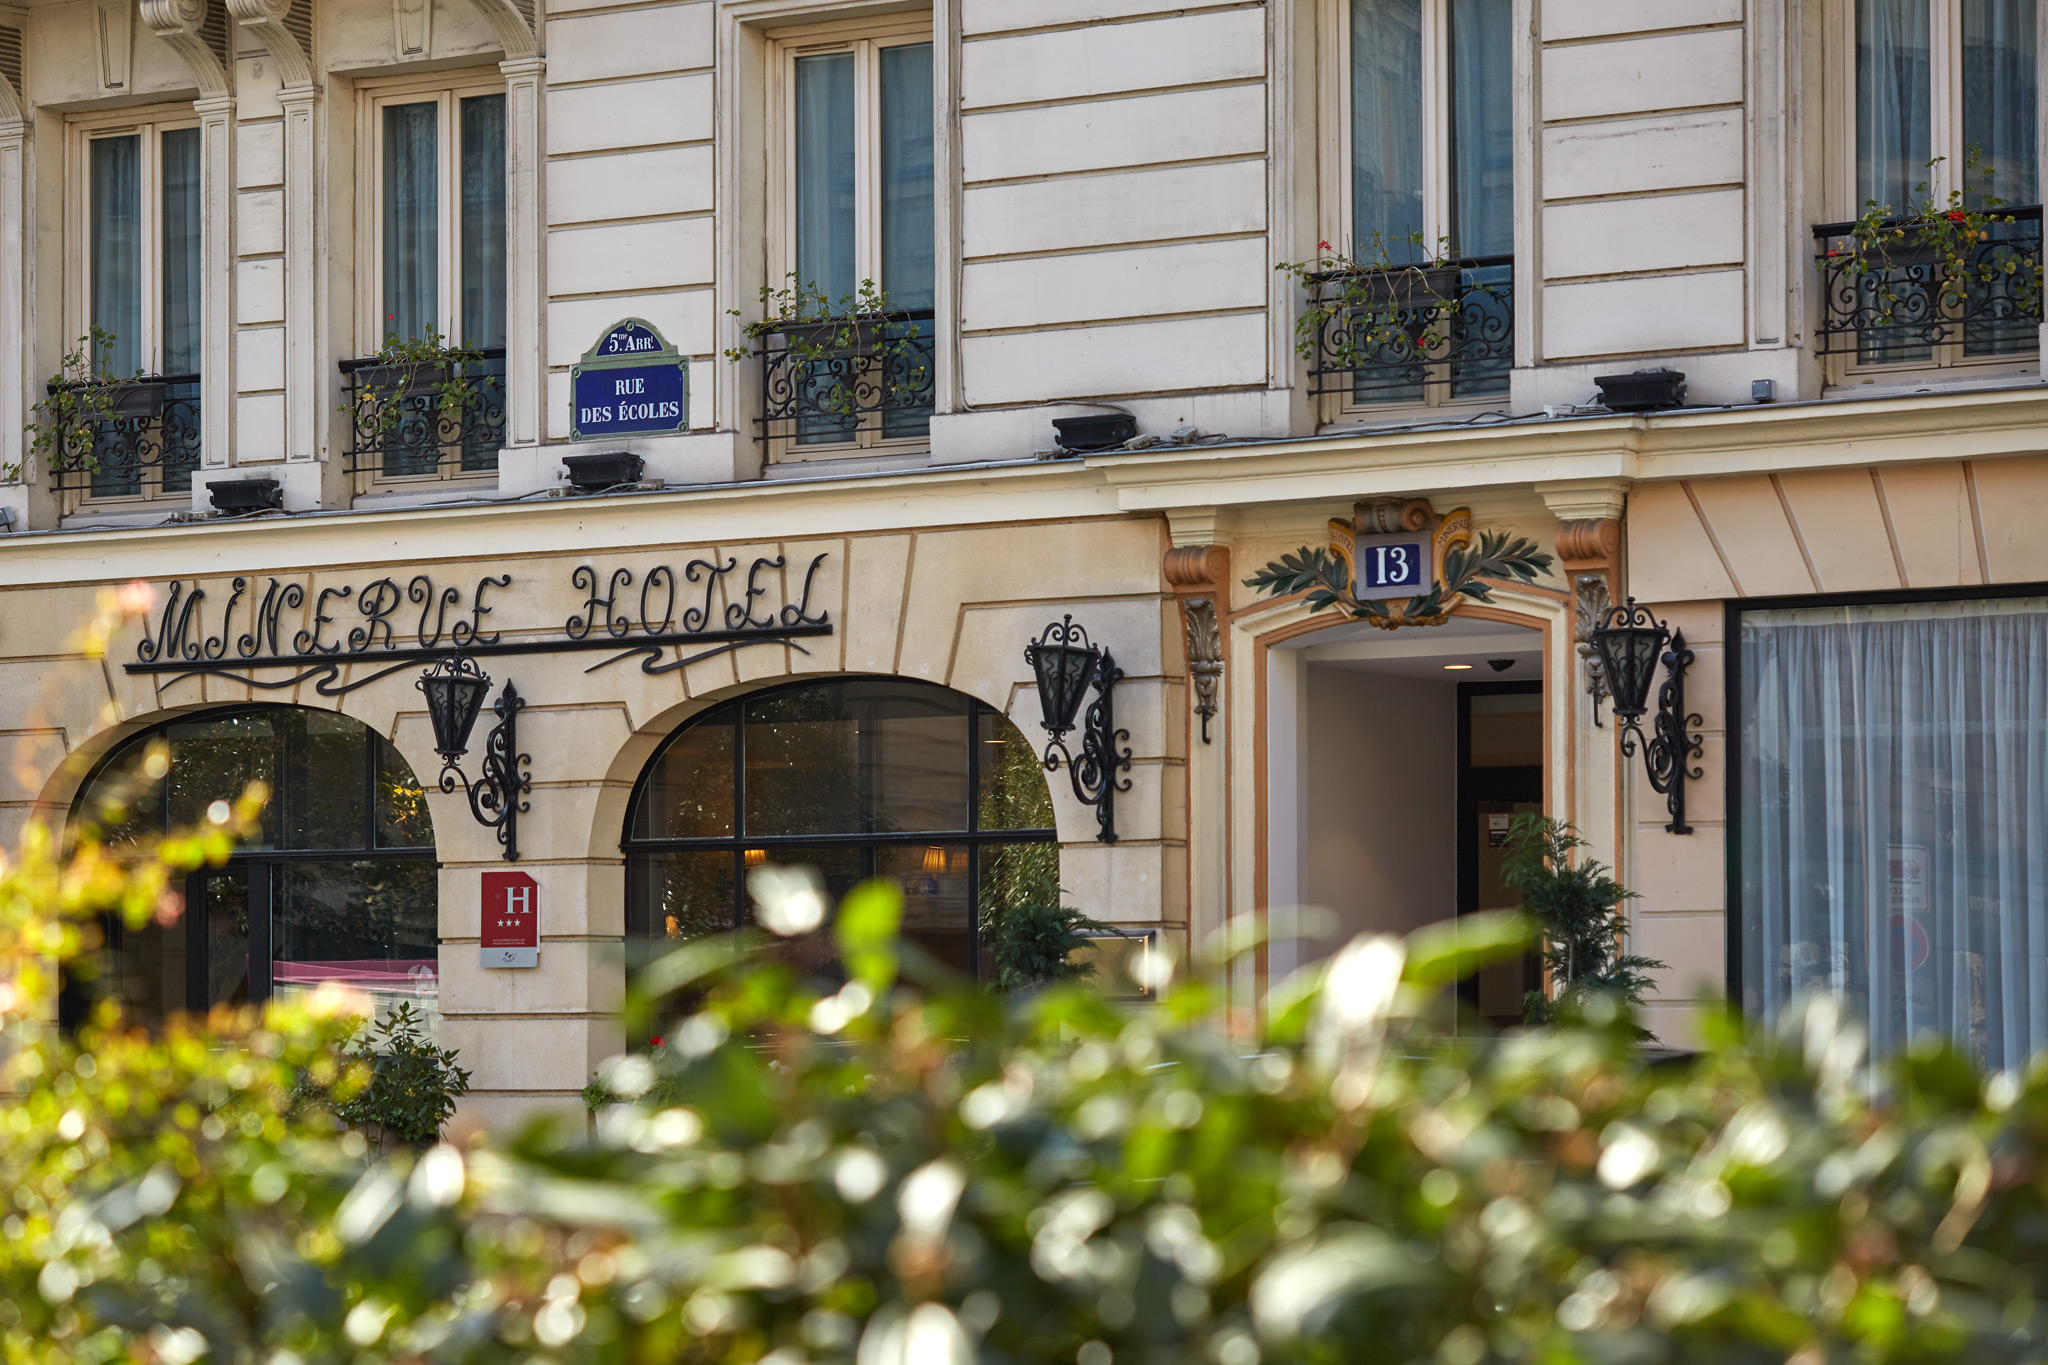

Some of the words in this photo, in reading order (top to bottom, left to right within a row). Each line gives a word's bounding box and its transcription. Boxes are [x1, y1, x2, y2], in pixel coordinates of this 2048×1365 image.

[615, 378, 645, 395] RUE
[581, 406, 612, 424] DES
[618, 401, 680, 421] ÉCOLES
[1331, 531, 1354, 554] HOTEL
[1376, 547, 1409, 584] 13
[137, 574, 512, 662] MINERVE
[566, 553, 829, 640] HOTEL
[504, 886, 532, 914] H
